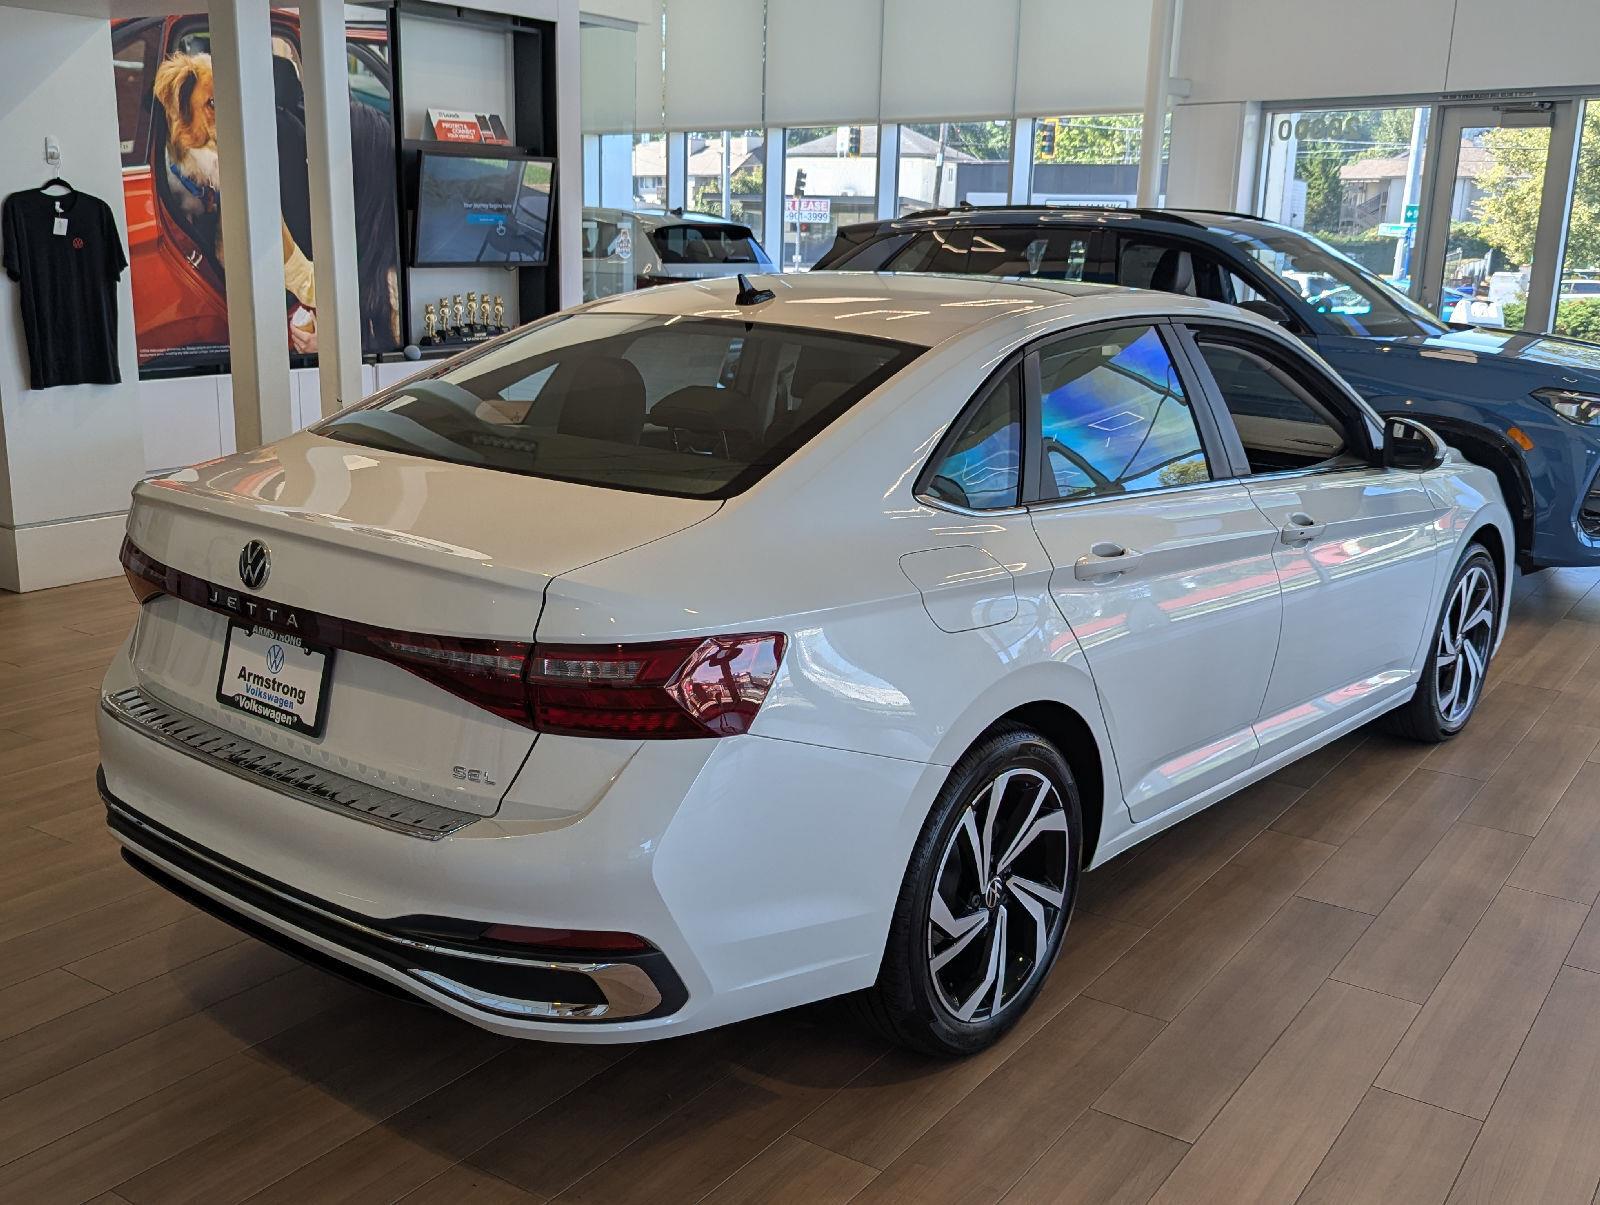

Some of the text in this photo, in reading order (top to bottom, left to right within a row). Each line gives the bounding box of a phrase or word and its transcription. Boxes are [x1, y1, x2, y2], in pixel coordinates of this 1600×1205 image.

[209, 591, 298, 628] JETTA
[252, 625, 302, 647] ARMSTRONG
[237, 666, 306, 705] Armstrong
[245, 683, 294, 710] Volkswagen
[452, 765, 496, 786] SEL
